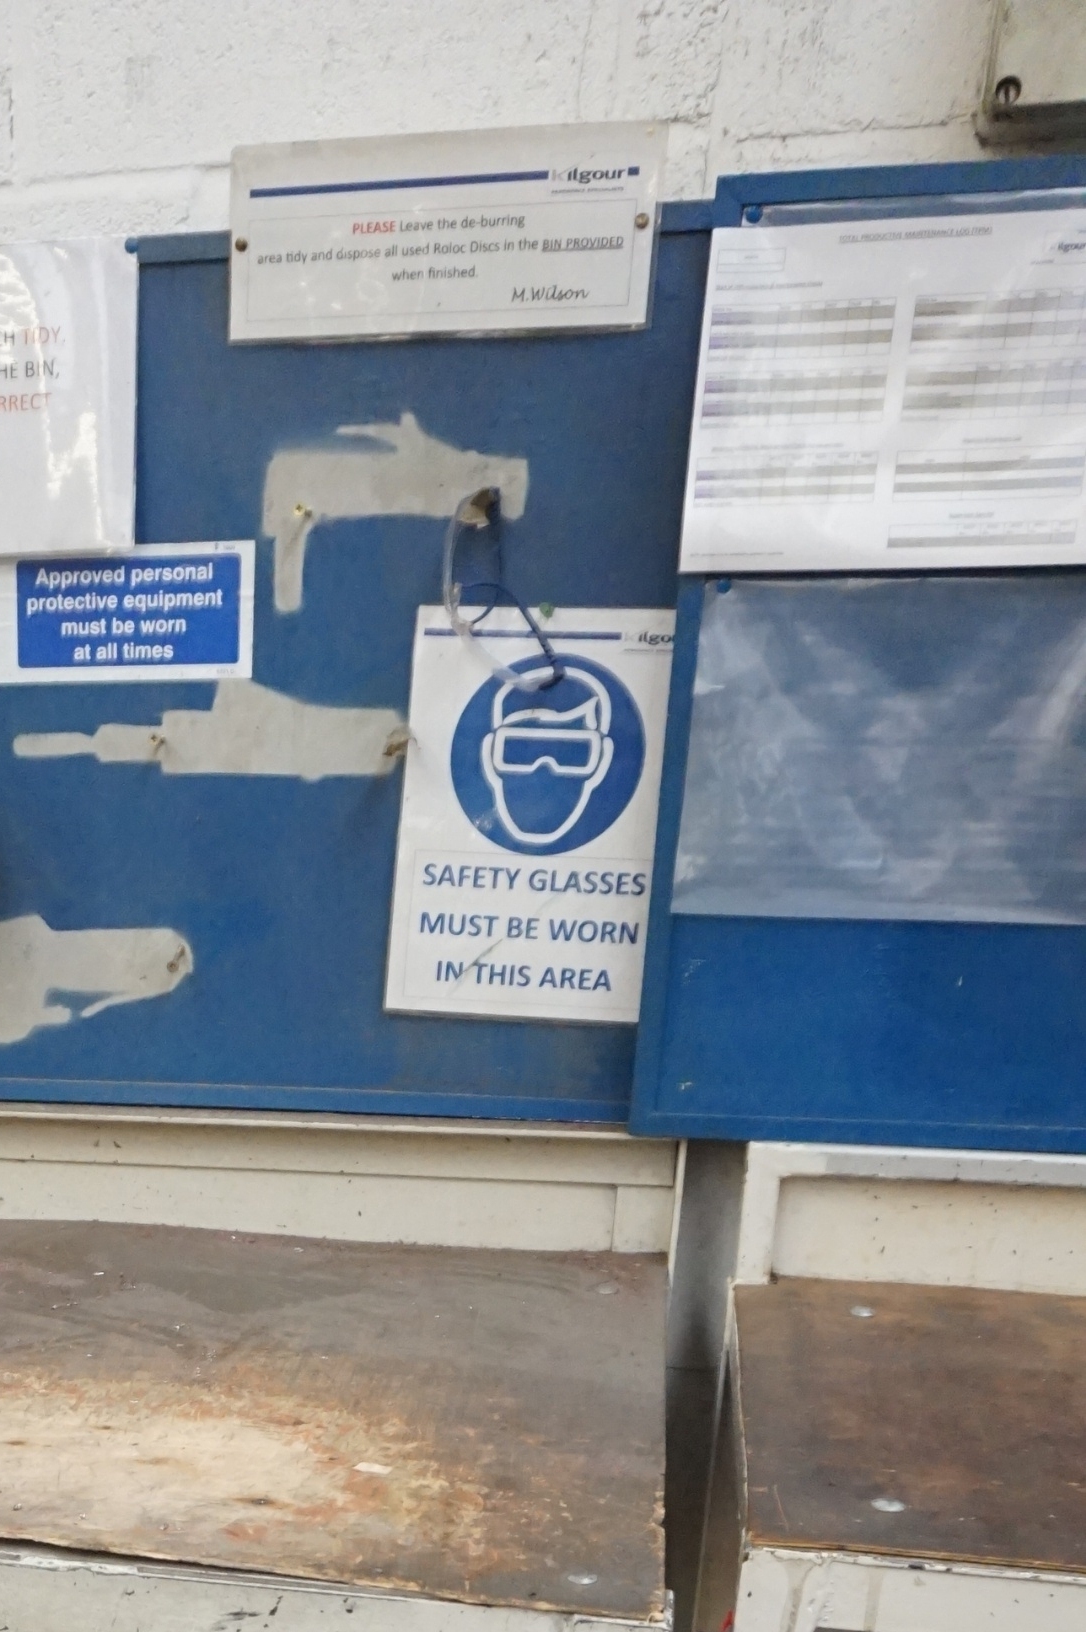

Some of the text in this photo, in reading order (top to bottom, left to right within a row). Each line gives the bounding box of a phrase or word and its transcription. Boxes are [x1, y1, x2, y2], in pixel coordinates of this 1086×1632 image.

[352, 214, 525, 235] PLEASE Leave the de-burring
[257, 235, 624, 265] area tidy and dispose all used Roloc Discs in the BIN PROVIDED
[392, 267, 424, 281] when
[25, 358, 60, 380] BIN,
[35, 562, 214, 589] Approved personal
[26, 588, 223, 615] protective equipment
[61, 616, 187, 636] must be worn
[625, 631, 673, 646] ilgo
[73, 642, 174, 661] at all times
[422, 863, 647, 896] SAFETY GLASSES
[419, 912, 640, 945] MUST BE WORN
[435, 960, 613, 992] IN THIS AREA
